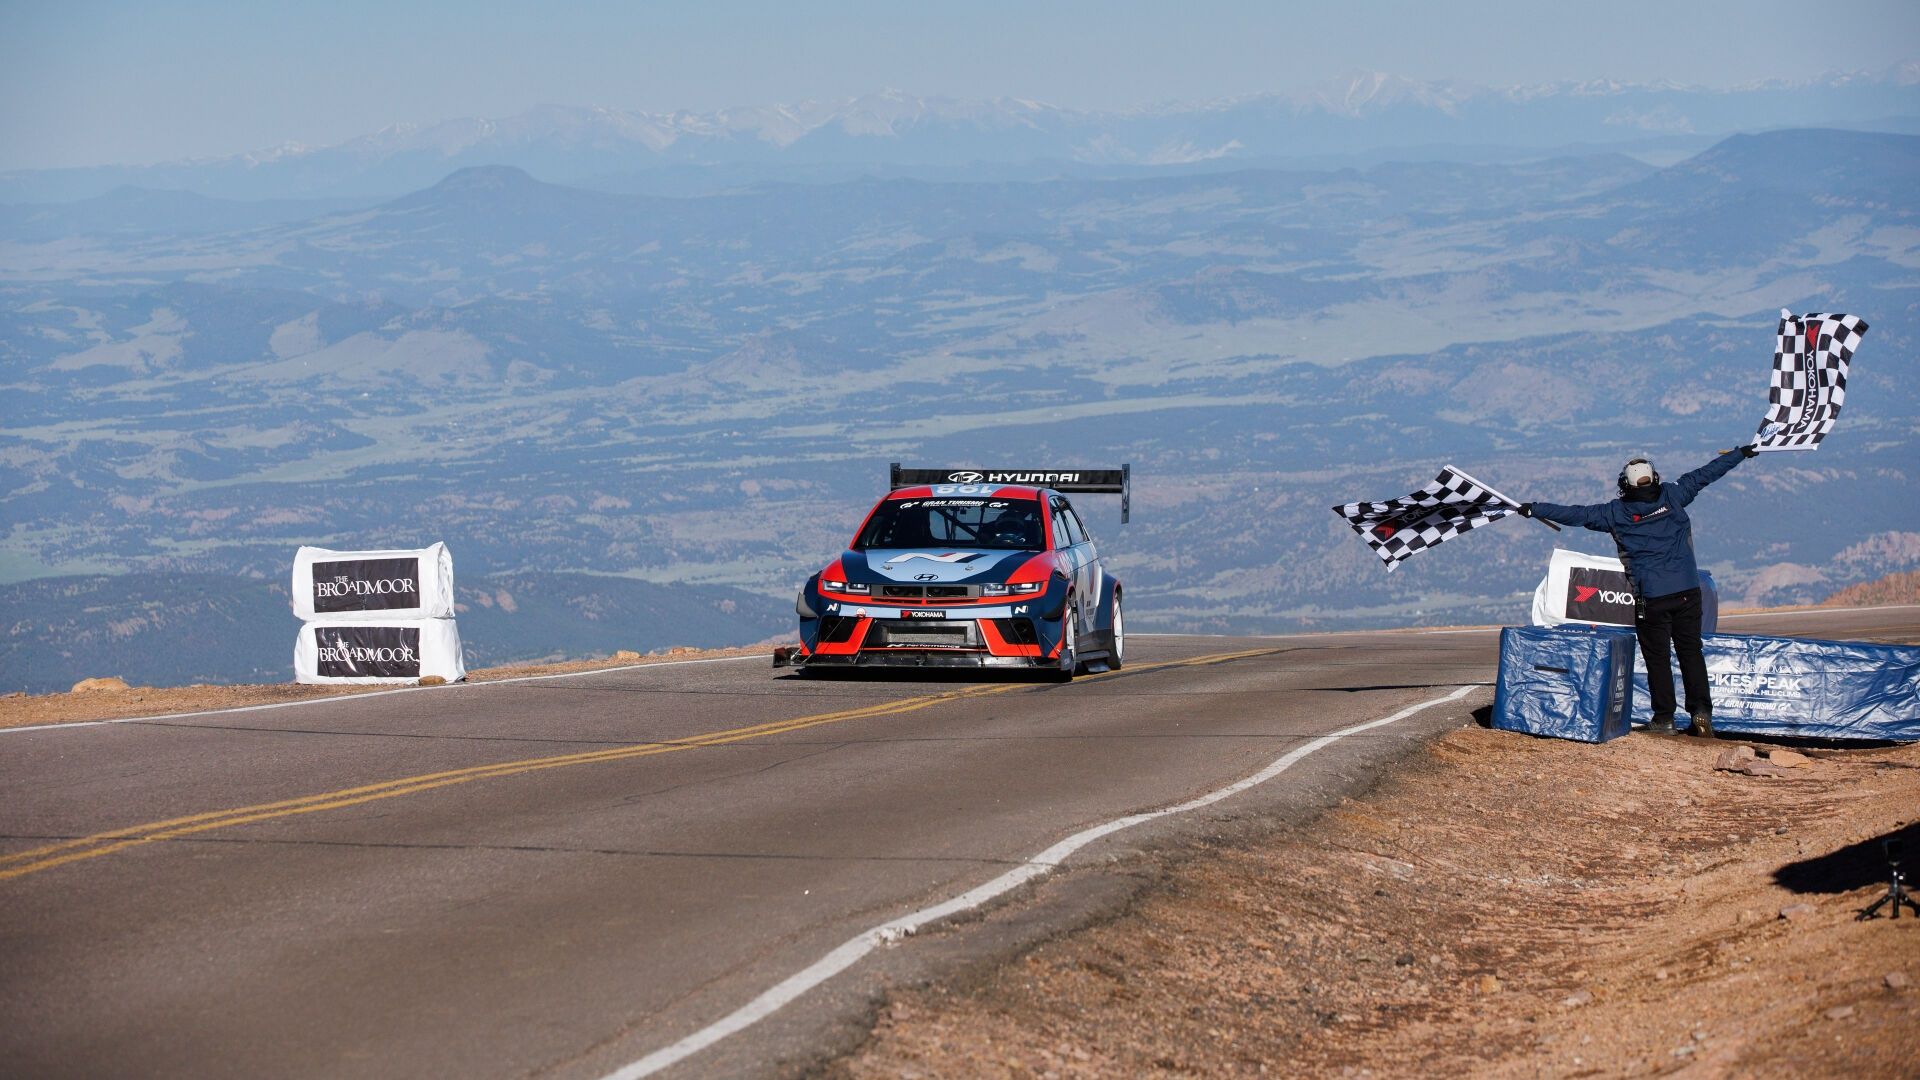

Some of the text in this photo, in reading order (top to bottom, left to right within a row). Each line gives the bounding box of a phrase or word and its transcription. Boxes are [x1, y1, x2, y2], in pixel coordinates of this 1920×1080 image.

[1796, 350, 1818, 430] YOKOHAMA
[988, 473, 1080, 482] HYUNDAI
[334, 575, 349, 583] THE
[317, 578, 415, 597] BROADMOOR
[318, 647, 416, 662] BROADMOOR
[1707, 673, 1802, 691] PIKES PEAK
[1710, 686, 1760, 695] TERNATIONAL
[1725, 699, 1777, 711] GRAN TURISMO
